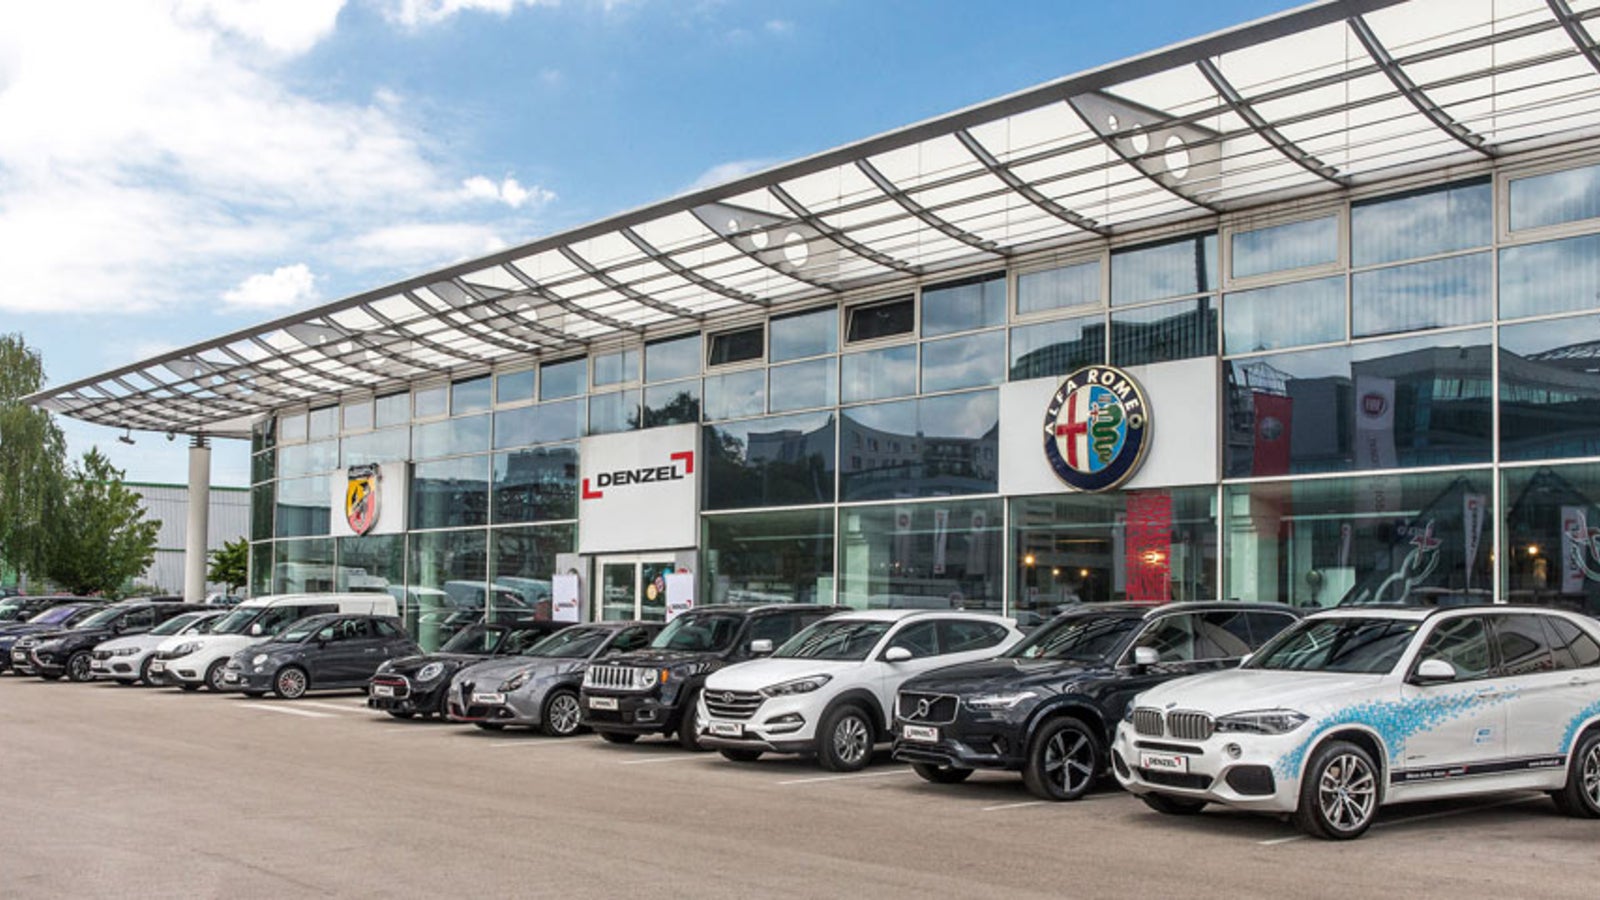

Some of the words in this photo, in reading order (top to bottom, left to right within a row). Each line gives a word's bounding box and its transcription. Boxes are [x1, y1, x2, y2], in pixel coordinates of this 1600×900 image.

[1045, 380, 1077, 436] ALFA
[1087, 369, 1143, 429] ROMEO
[597, 465, 684, 487] DENZEL
[1149, 757, 1177, 768] DENZEL
